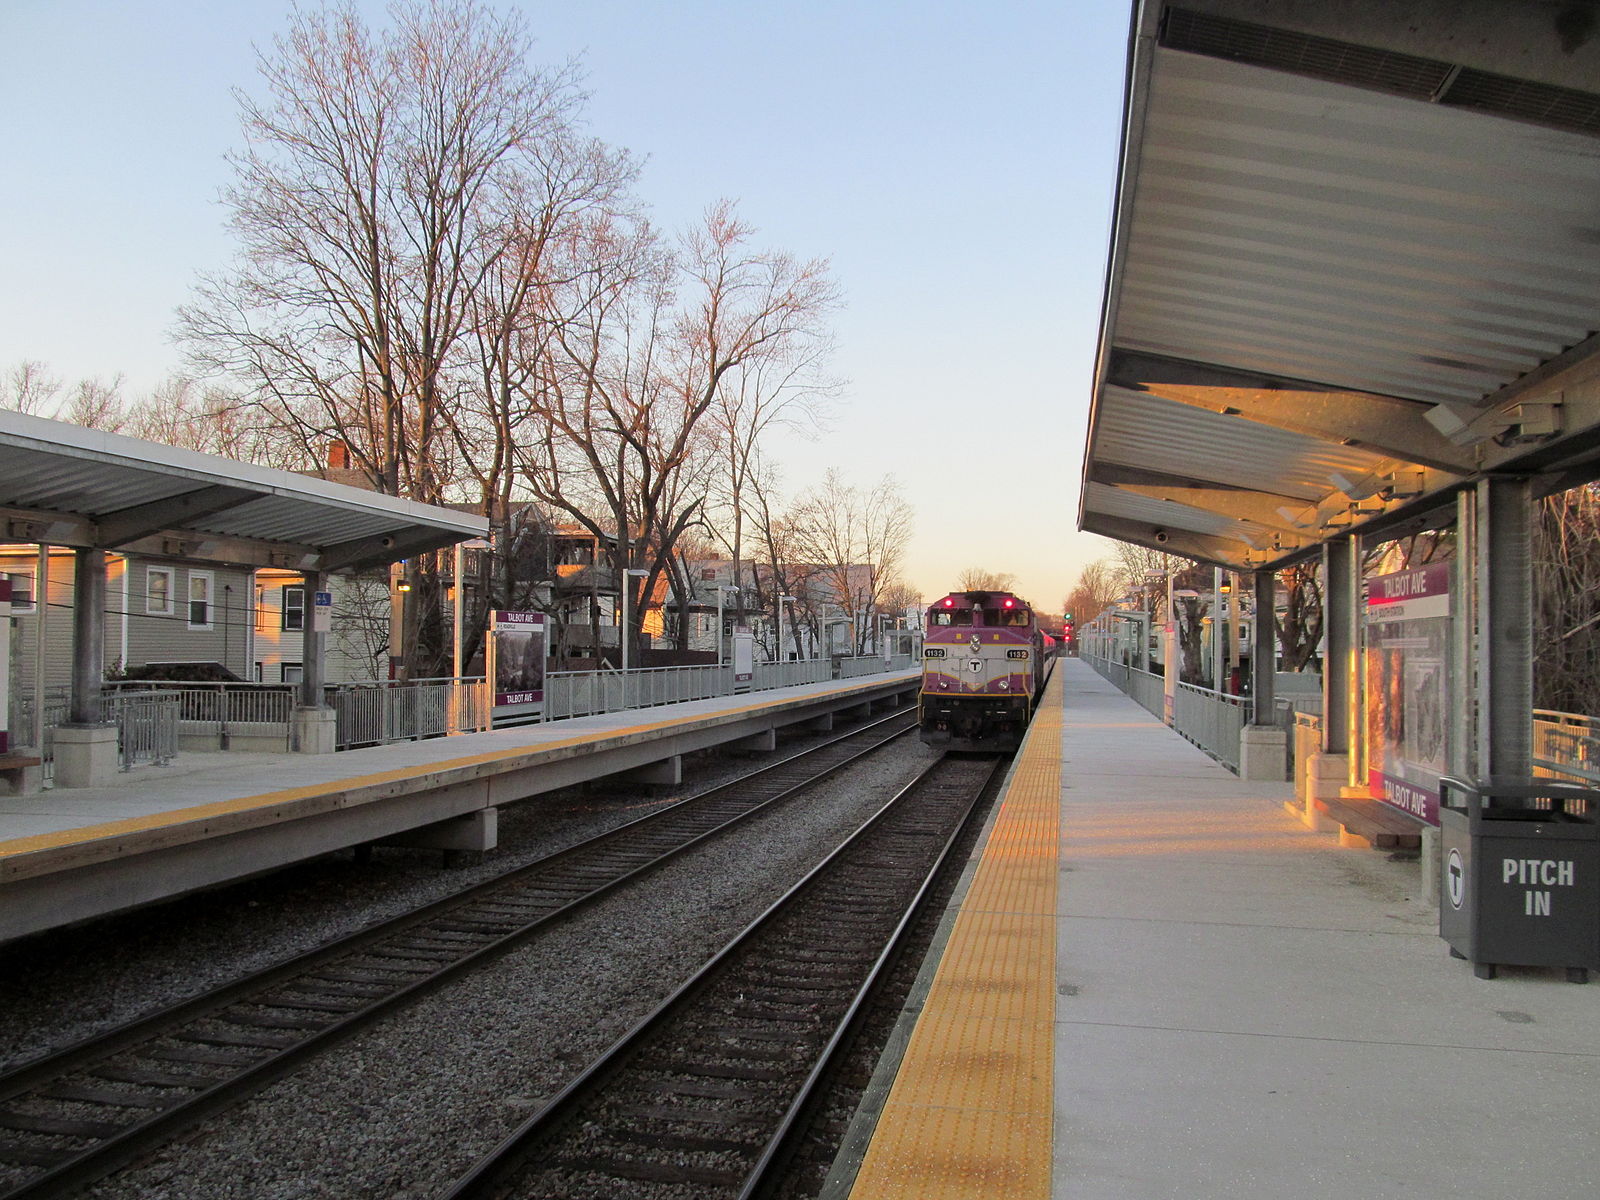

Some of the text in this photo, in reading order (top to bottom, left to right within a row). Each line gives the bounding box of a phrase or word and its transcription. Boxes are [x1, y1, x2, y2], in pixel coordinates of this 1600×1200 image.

[1384, 571, 1426, 598] TALBOT AVE
[507, 612, 534, 623] TALBOT AVE
[506, 693, 533, 704] TALBOT AVE
[1384, 780, 1426, 818] TALBOT AVE
[1503, 858, 1574, 886] PITCH
[1525, 890, 1550, 916] IN
